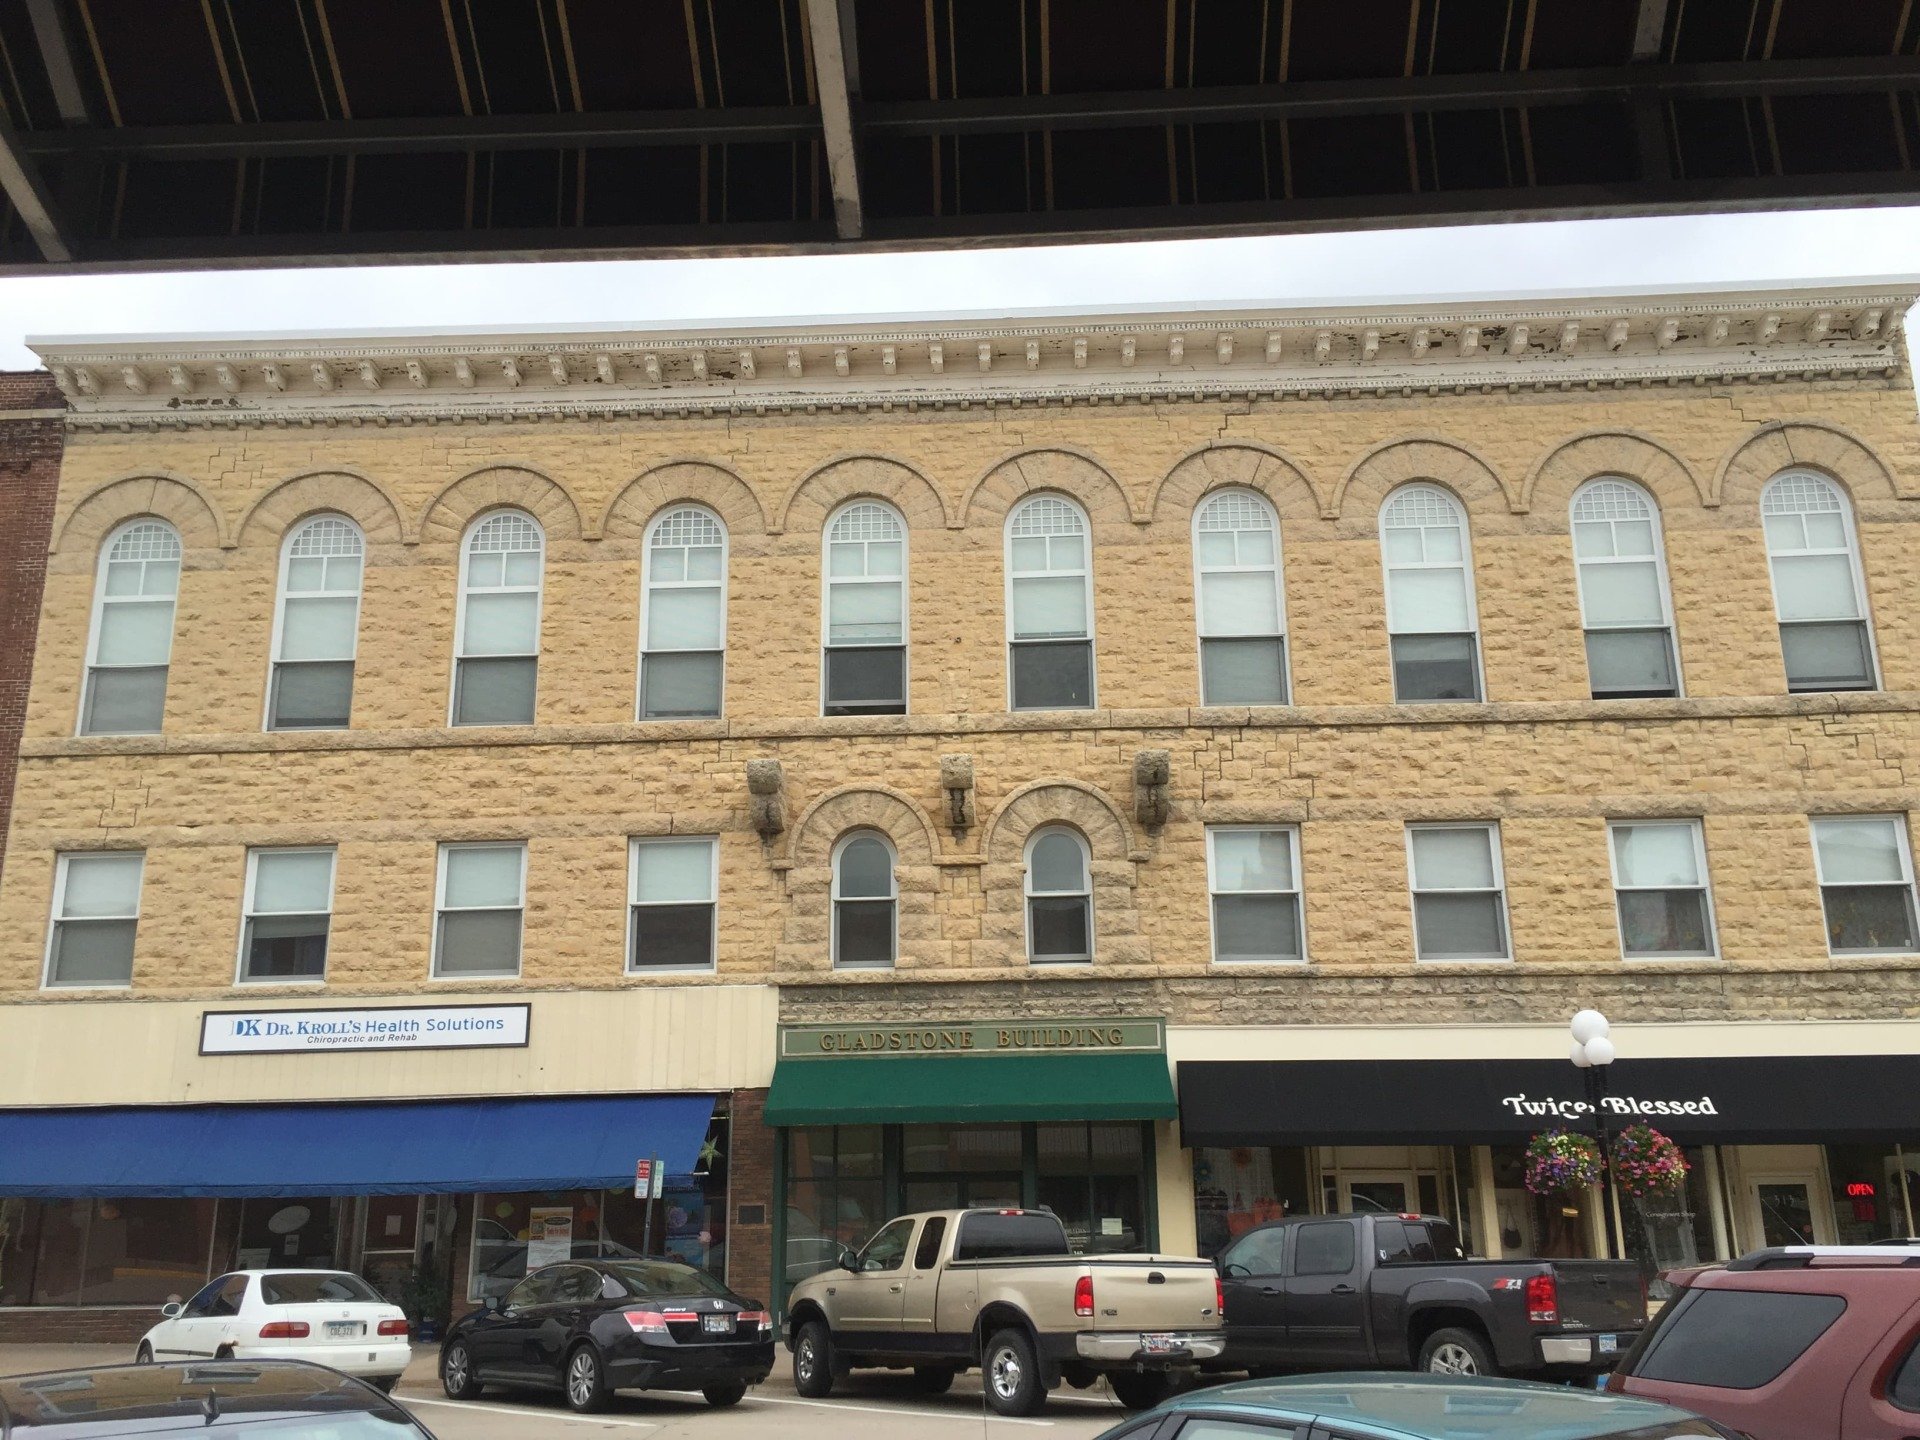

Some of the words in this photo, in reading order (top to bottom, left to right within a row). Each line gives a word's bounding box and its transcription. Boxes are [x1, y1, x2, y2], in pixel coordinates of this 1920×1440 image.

[365, 1020, 419, 1033] Health
[427, 1017, 504, 1031] Solutions
[307, 1036, 365, 1045] Chiropractic
[368, 1034, 385, 1042] and
[388, 1033, 417, 1042] Rehab
[820, 1031, 974, 1051] GLADSTONE
[996, 1027, 1123, 1047] BUILDING
[1601, 1096, 1719, 1116] Blessed
[1847, 1183, 1875, 1196] OPEN
